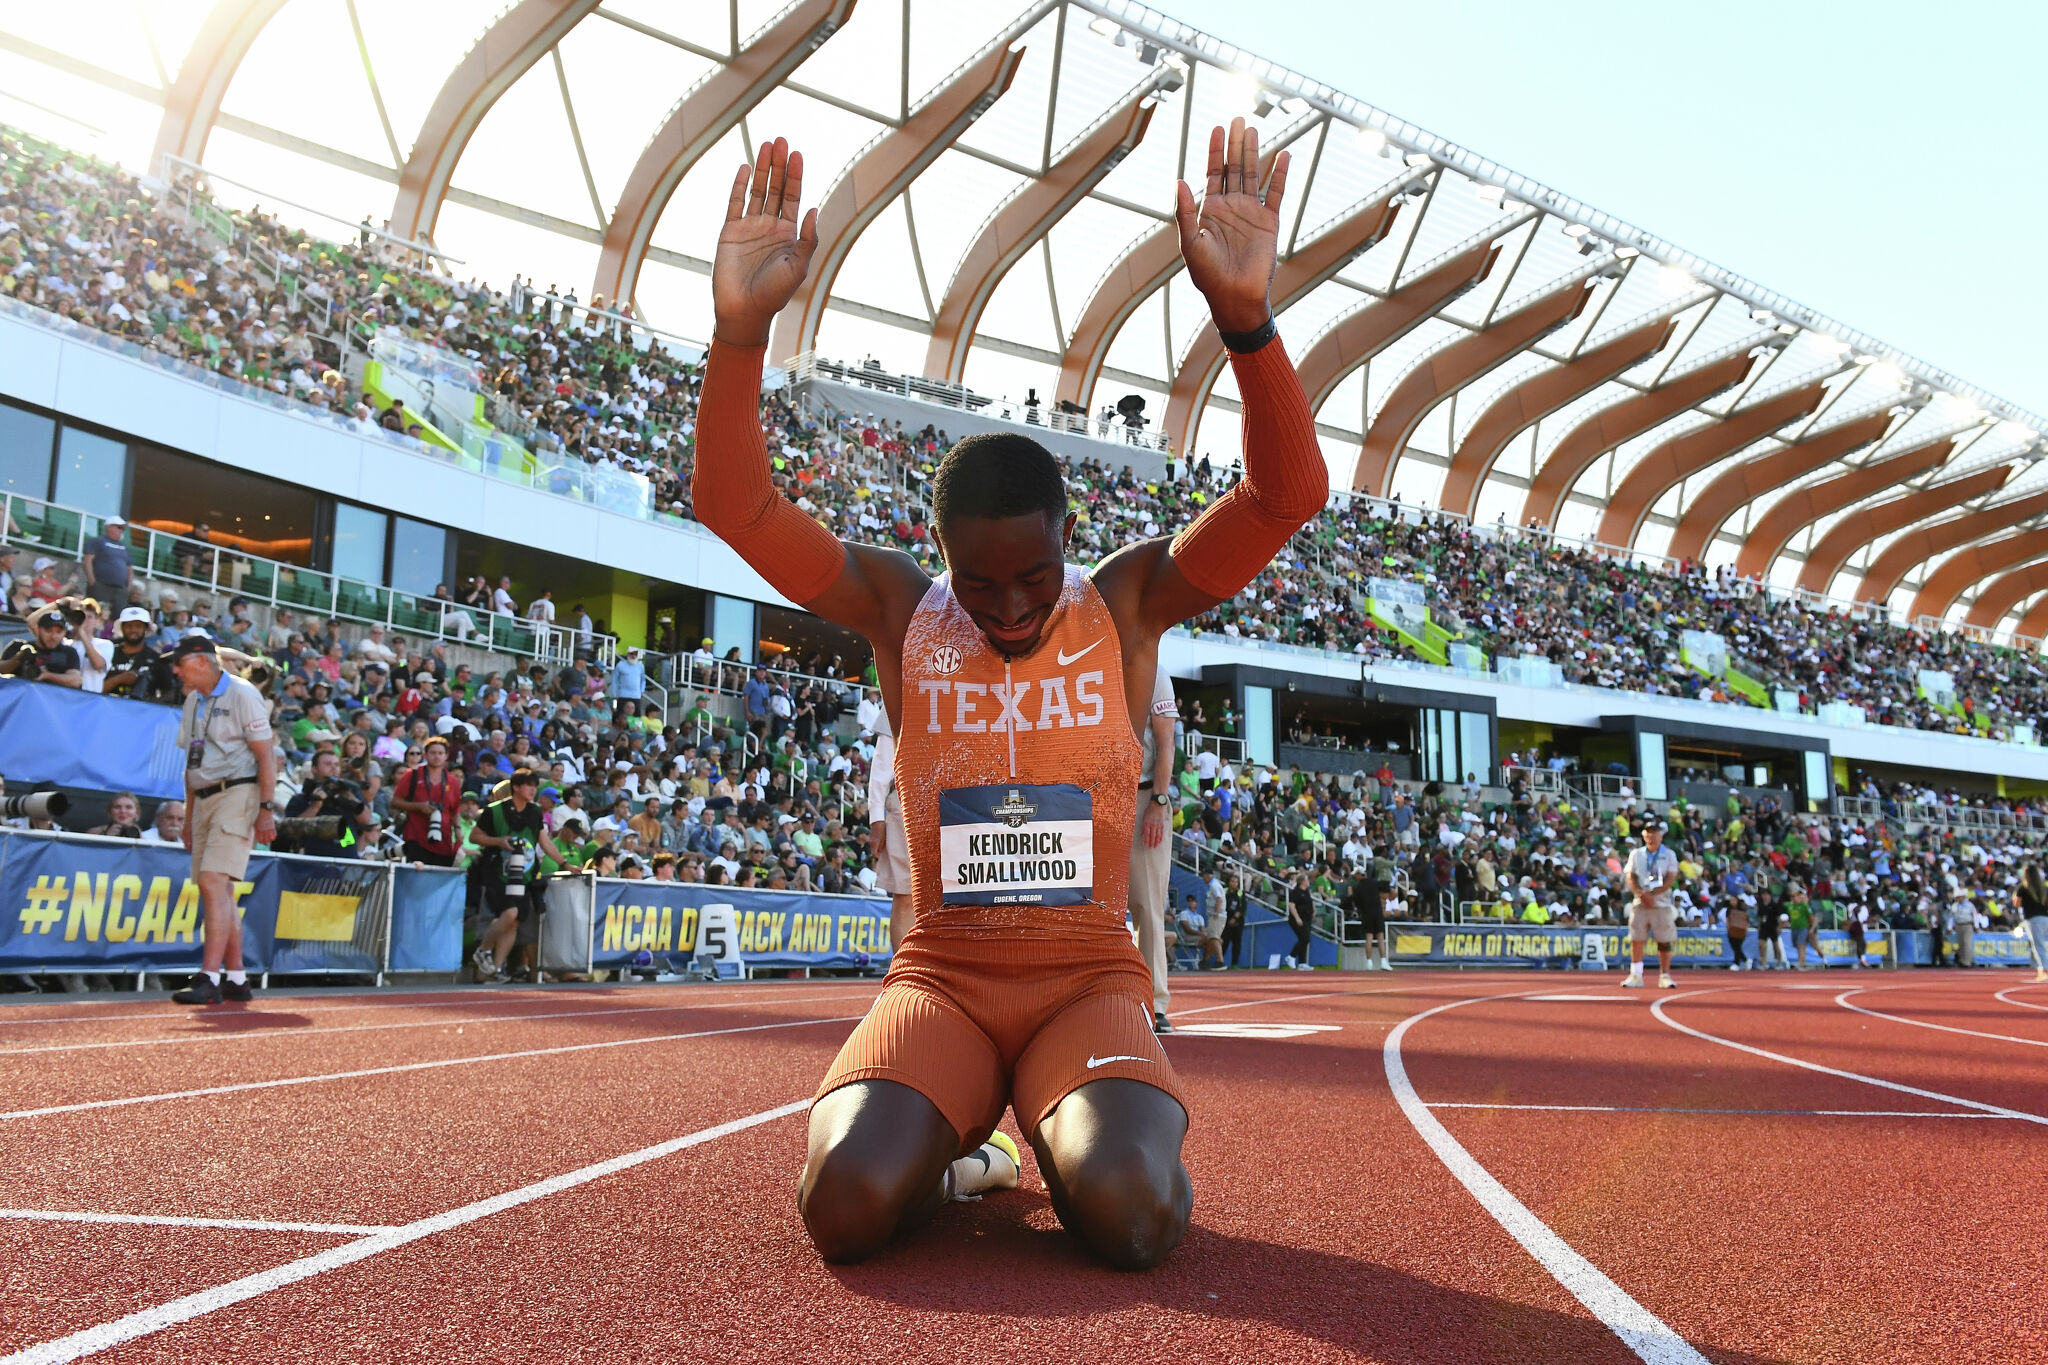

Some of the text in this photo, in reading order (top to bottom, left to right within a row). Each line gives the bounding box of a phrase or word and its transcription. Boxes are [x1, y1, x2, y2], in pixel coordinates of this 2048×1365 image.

[933, 647, 962, 673] SEC
[918, 670, 1104, 734] TEXAS
[969, 832, 1063, 857] KENDRICK
[957, 859, 1077, 886] SMALLWOOD
[994, 894, 1043, 904] EUGENE, OREGON
[602, 904, 672, 952] NCAA
[787, 912, 833, 953] AND
[837, 914, 892, 954] FIELD
[705, 927, 726, 959] 5
[1443, 933, 1482, 957] NCAA
[1485, 934, 1503, 957] DI
[1505, 934, 1551, 957] TRACK
[1553, 935, 1581, 957] AND
[1587, 944, 1597, 960] 2
